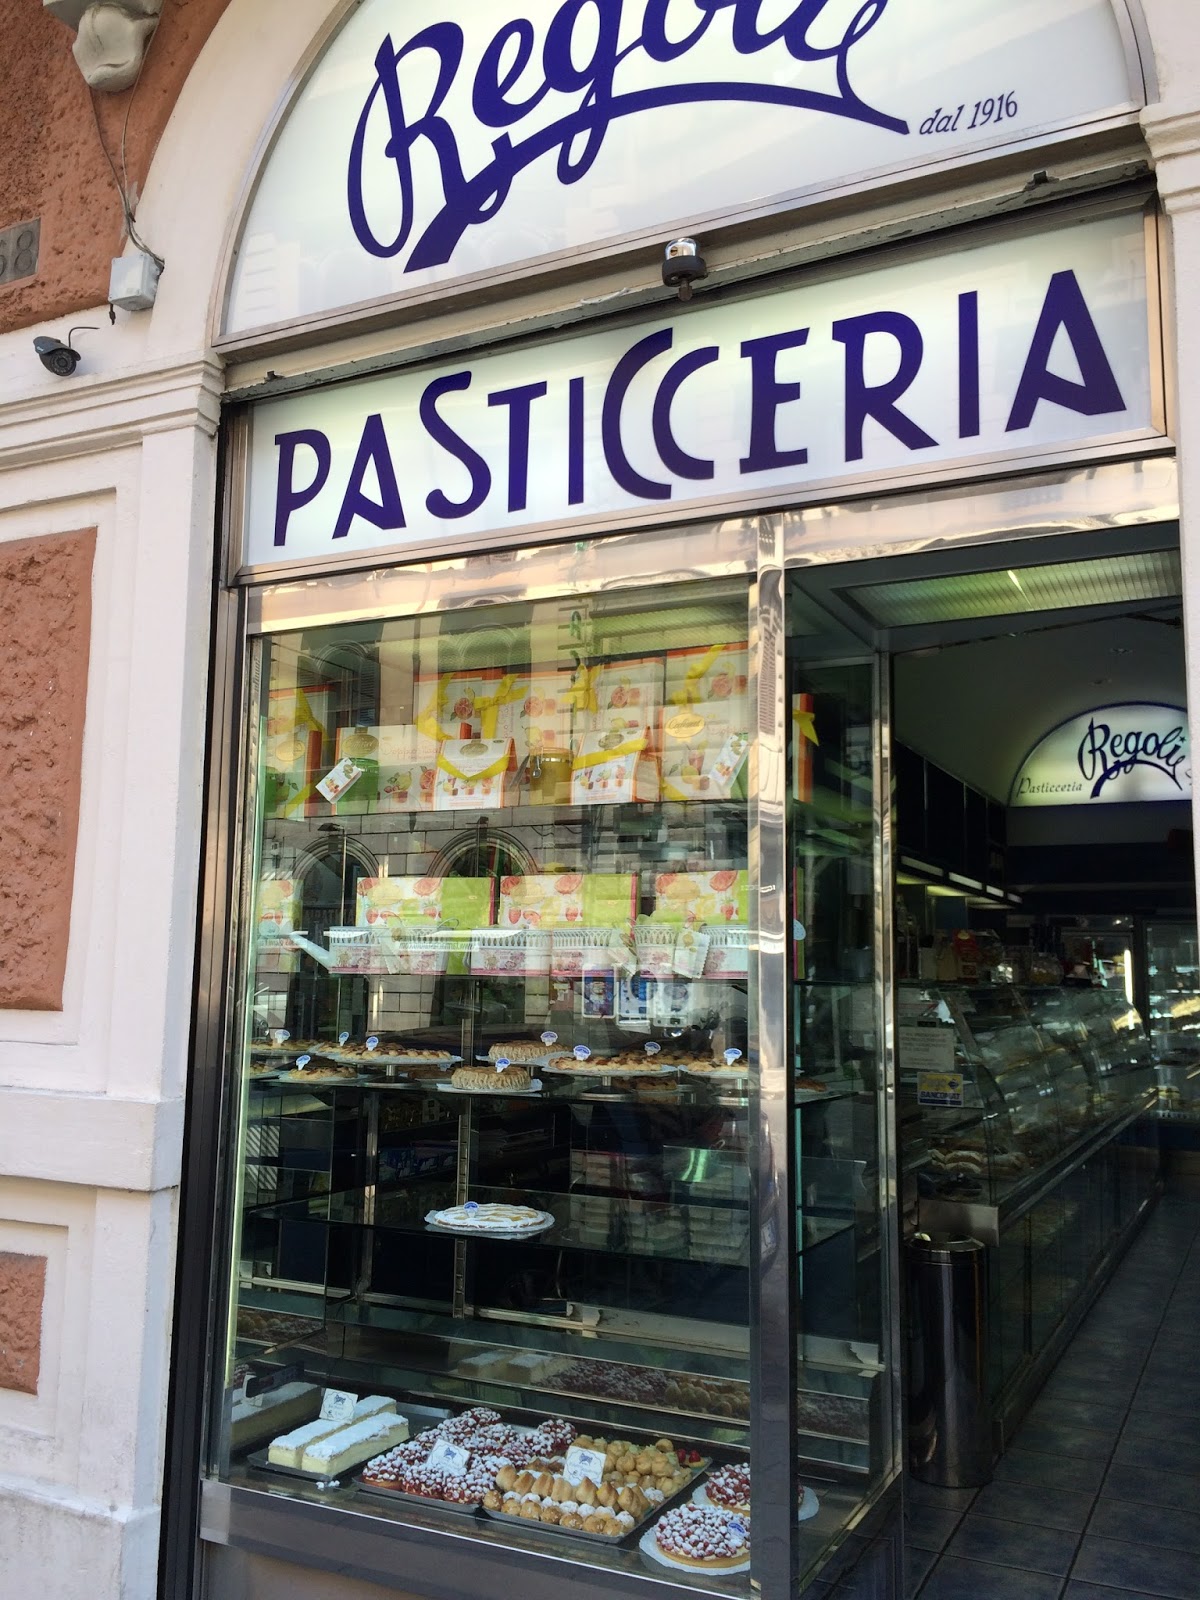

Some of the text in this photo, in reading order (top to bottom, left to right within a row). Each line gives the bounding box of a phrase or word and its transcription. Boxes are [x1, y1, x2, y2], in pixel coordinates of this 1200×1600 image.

[919, 91, 1018, 135] dal 1916
[273, 269, 1127, 546] PASTICCERIA
[1016, 777, 1083, 798] Pasticceria
[1077, 717, 1186, 800] Regoli
